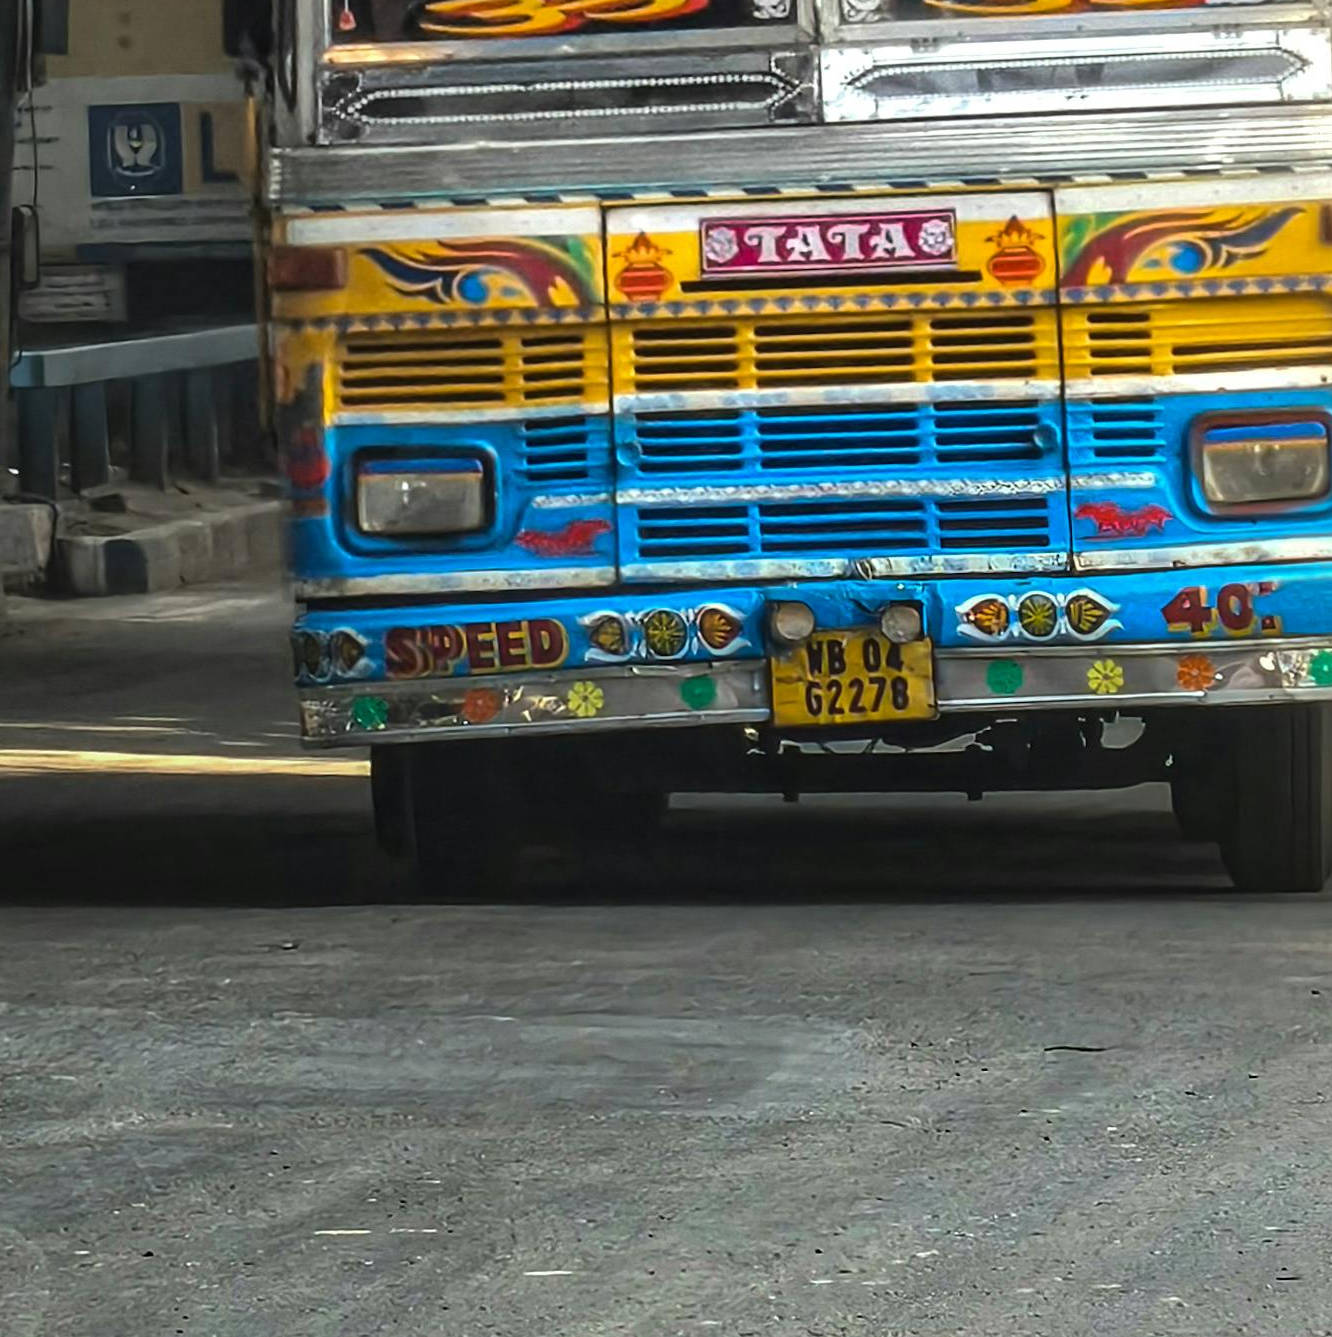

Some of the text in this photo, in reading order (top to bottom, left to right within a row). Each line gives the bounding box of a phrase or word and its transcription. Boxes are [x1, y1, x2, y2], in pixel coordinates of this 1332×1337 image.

[743, 221, 917, 264] TATA
[385, 617, 568, 680] SPEED
[805, 637, 905, 676] WB 04
